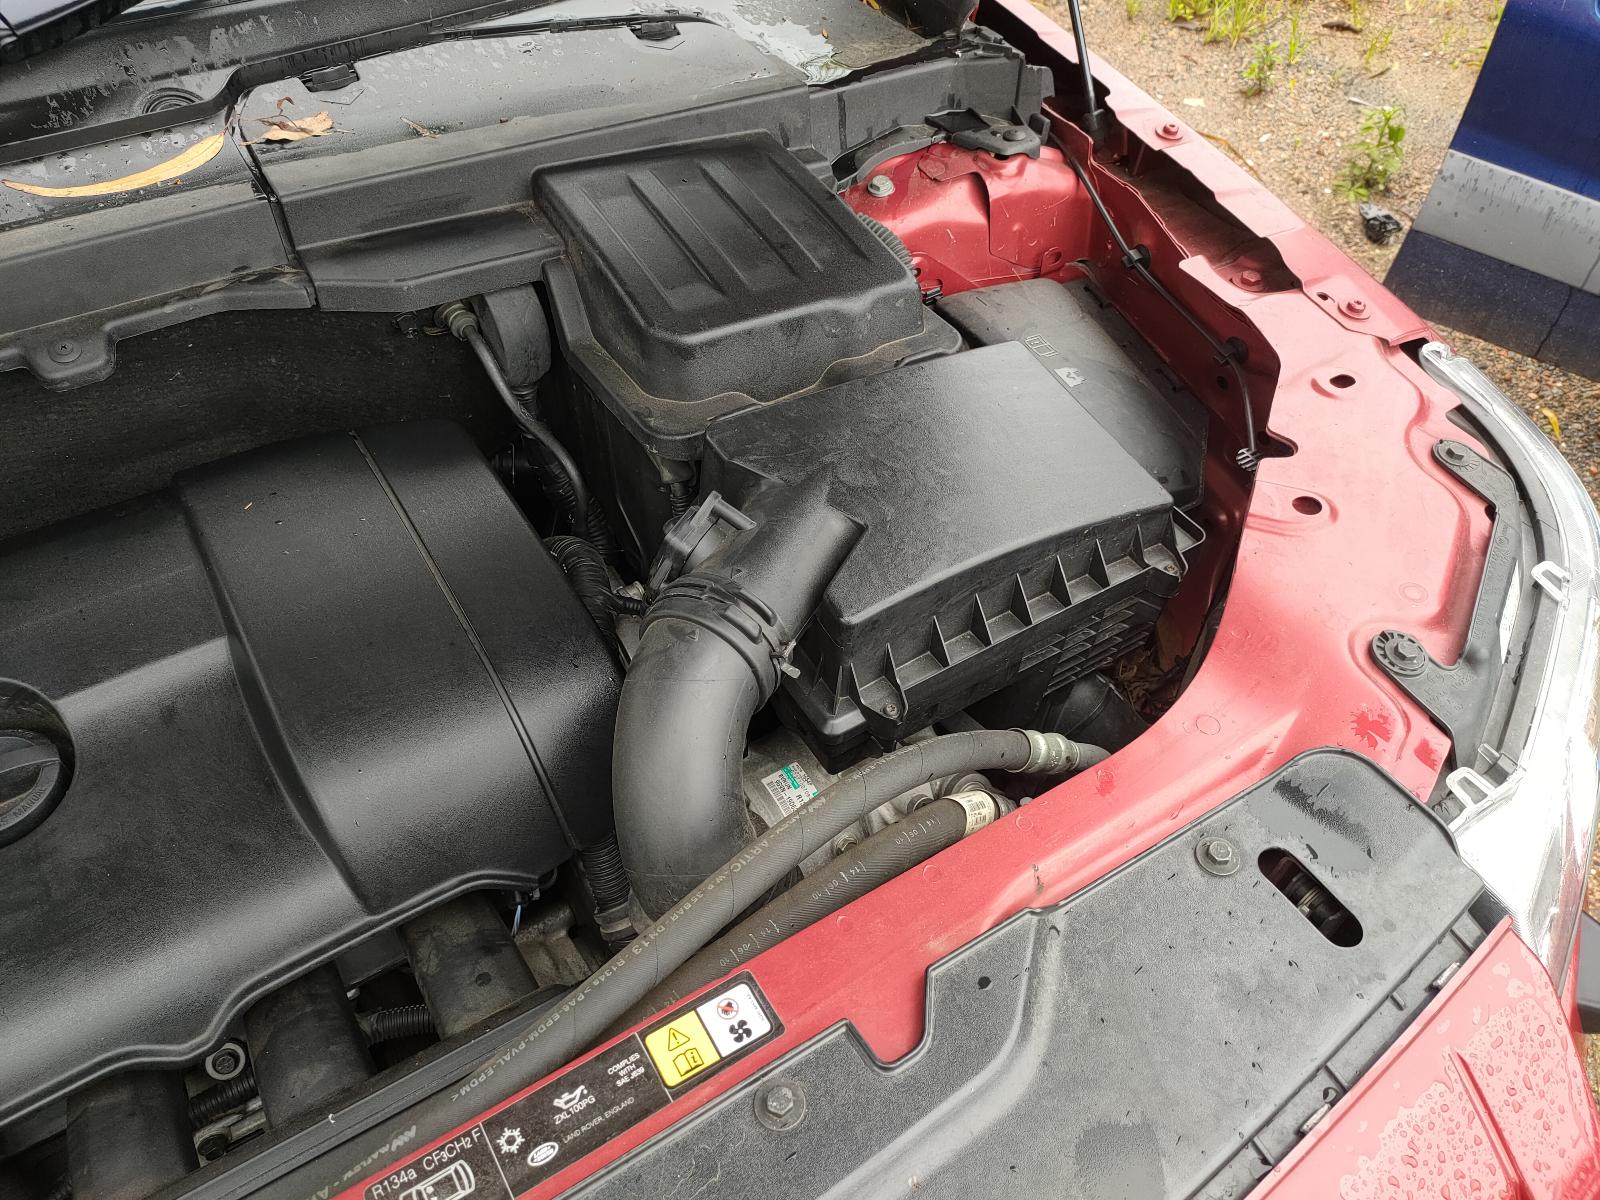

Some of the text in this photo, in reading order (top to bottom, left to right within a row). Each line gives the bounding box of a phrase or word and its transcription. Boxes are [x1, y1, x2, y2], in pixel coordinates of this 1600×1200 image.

[608, 1052, 640, 1074] COMPLIES
[618, 1063, 636, 1076] WITH
[616, 1076, 630, 1087] SAE
[552, 1094, 596, 1124] ZXL100PG
[562, 1128, 581, 1143] LAND
[603, 1096, 635, 1118] ENGLAND
[371, 1168, 418, 1200] R134a
